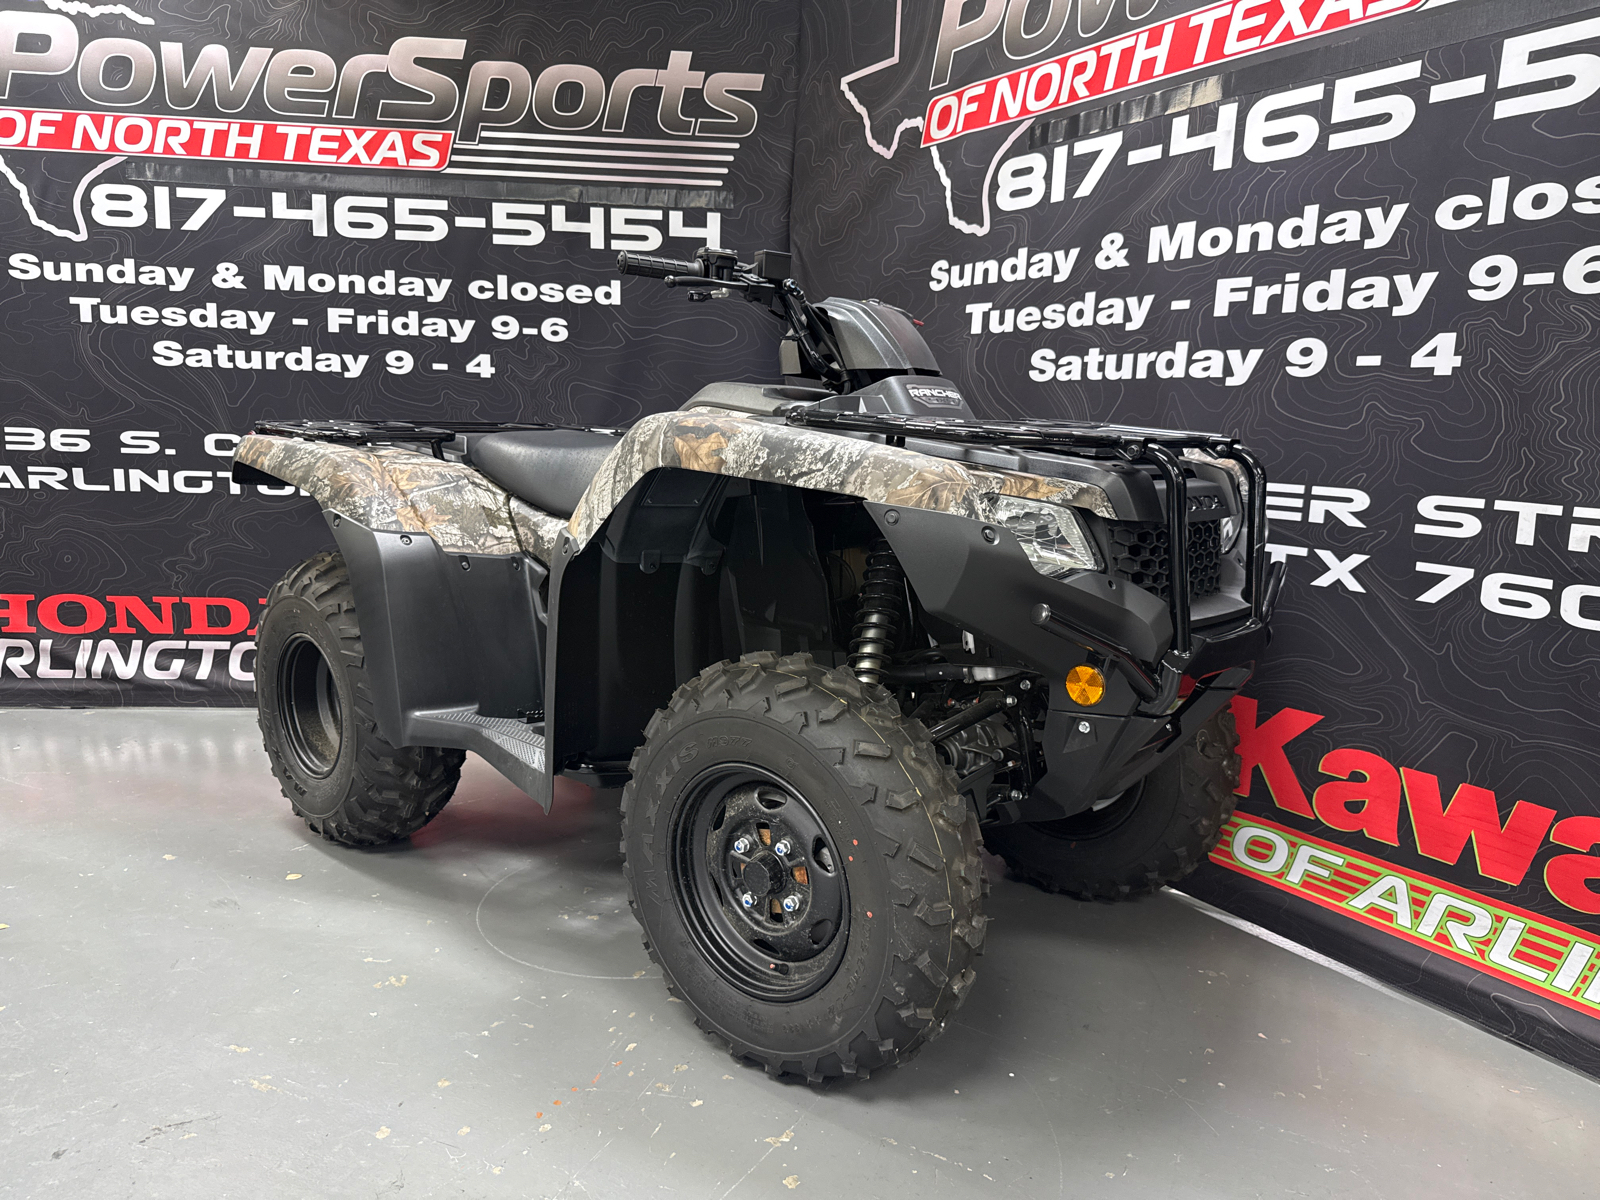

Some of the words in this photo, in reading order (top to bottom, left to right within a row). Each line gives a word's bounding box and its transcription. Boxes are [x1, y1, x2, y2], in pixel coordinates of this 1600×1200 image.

[0, 10, 766, 145] PowerSports
[929, 84, 987, 140] OF
[988, 22, 1175, 124] NORTH
[1188, 0, 1414, 66] TEXA
[0, 110, 63, 147] OF
[71, 114, 264, 159] NORTH
[275, 126, 443, 168] TEXAS
[91, 184, 722, 254] 817-465-5454
[929, 246, 1081, 292] Sunday
[1094, 232, 1130, 271] &
[1147, 203, 1410, 264] Monday
[8, 253, 194, 291] Sunday
[212, 262, 246, 289] &
[264, 265, 453, 302] Monday
[467, 275, 621, 306] closed
[966, 292, 1156, 335] Tuesday
[1170, 299, 1191, 311] -
[1212, 269, 1440, 318] Friday
[69, 297, 275, 336] Tuesday
[293, 317, 309, 326] -
[328, 308, 476, 344] Friday
[491, 314, 569, 343] 9-6
[152, 341, 370, 379] Saturday
[386, 349, 414, 375] 9
[465, 353, 496, 379] 4
[1028, 341, 1265, 387] Saturday
[1285, 337, 1328, 378] 9
[1410, 331, 1463, 376] 4
[908, 388, 962, 400] RANCHER
[3, 427, 91, 453] 36
[120, 431, 176, 456] S.
[0, 465, 311, 497] ARLINGT
[0, 593, 267, 635] HOND
[1230, 825, 1345, 886] OF
